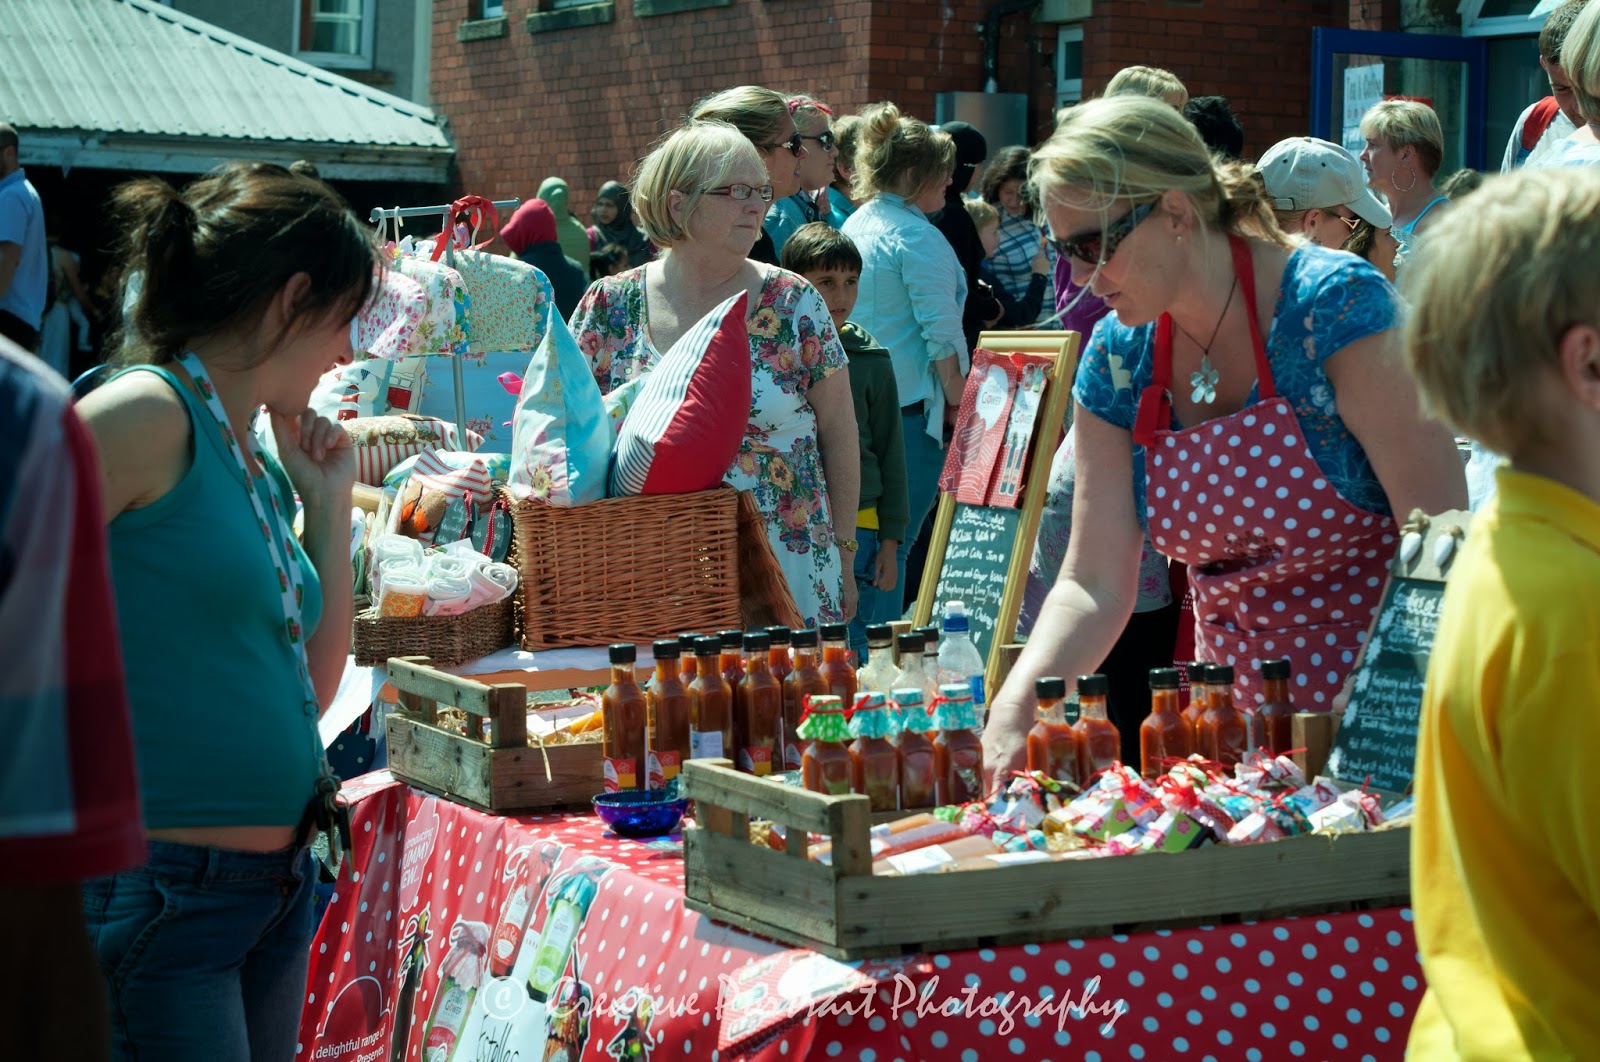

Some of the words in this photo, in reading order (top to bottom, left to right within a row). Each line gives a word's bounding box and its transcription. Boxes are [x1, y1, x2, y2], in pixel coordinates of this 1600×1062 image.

[402, 841, 431, 870] UMMY
[316, 1037, 360, 1059] delightful
[361, 1031, 380, 1046] range
[379, 1022, 387, 1038] of
